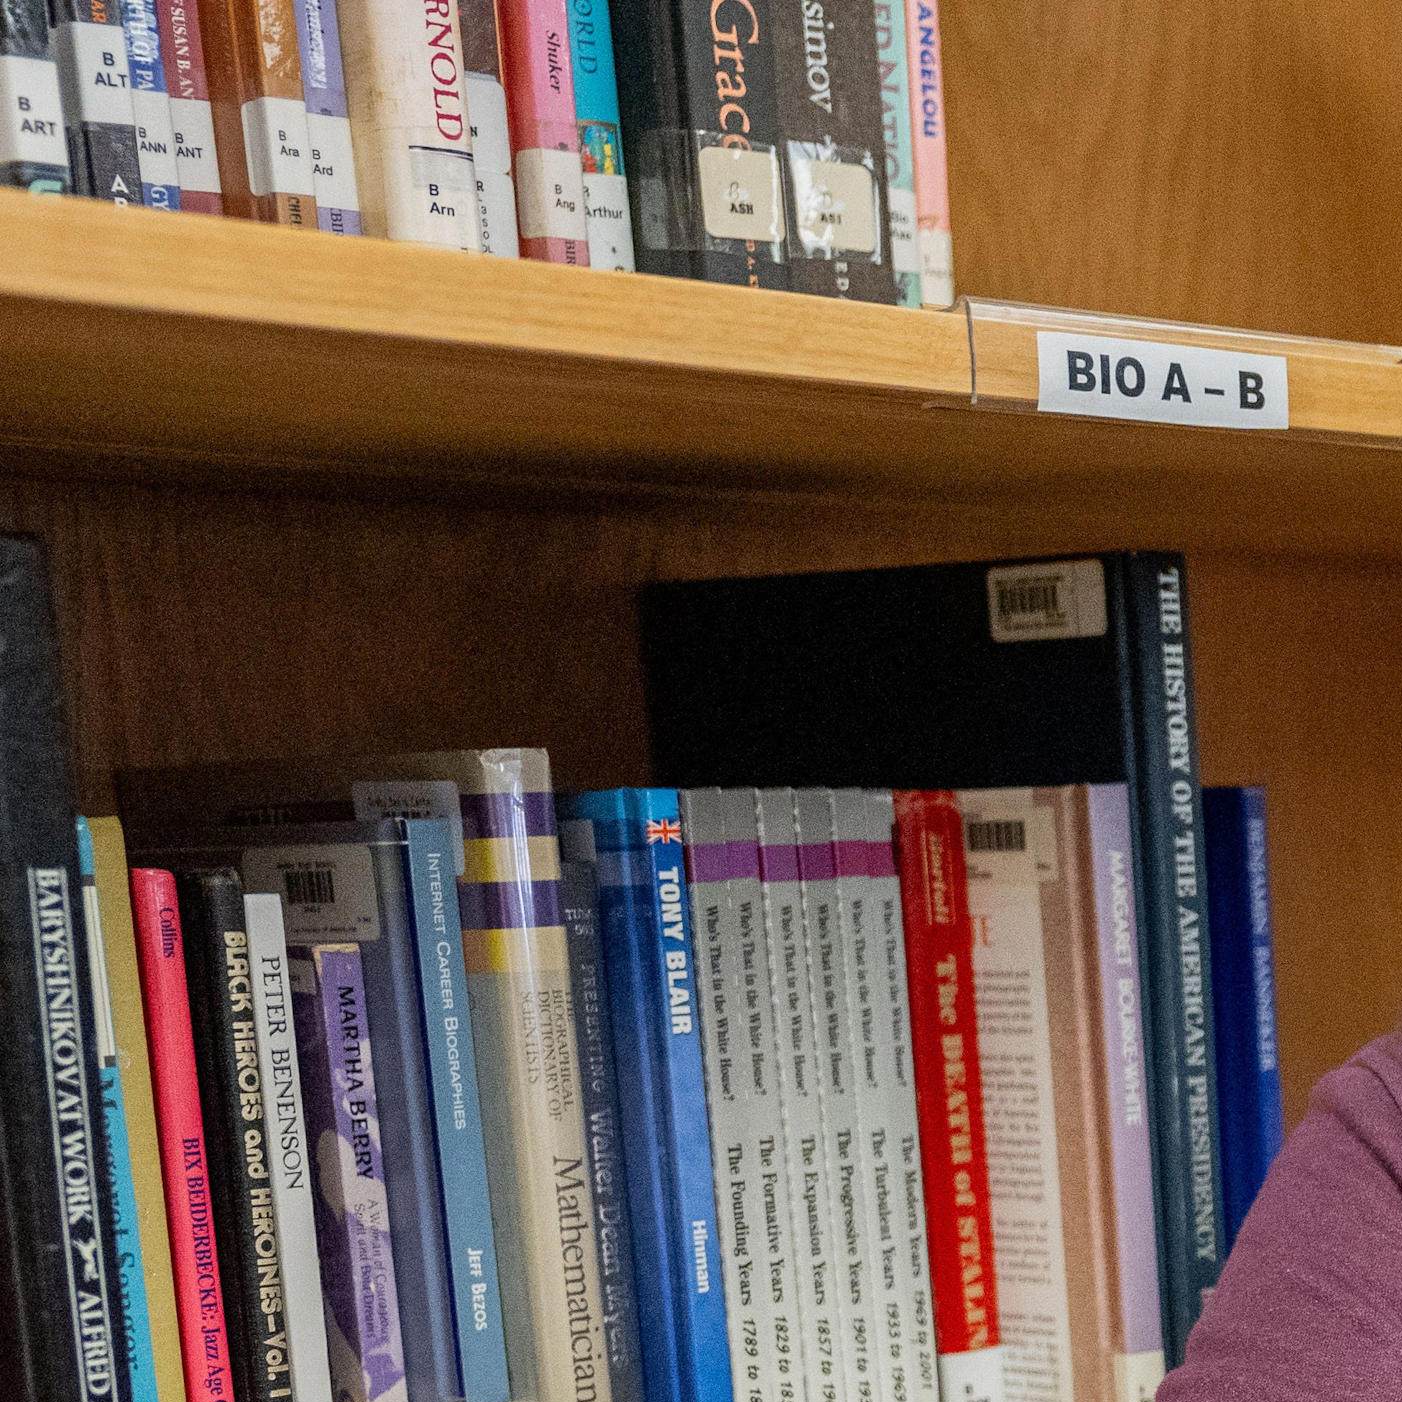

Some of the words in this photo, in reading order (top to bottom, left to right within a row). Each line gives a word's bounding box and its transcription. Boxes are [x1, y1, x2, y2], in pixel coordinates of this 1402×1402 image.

[170, 6, 189, 57] SUSAN
[102, 52, 115, 67] B
[425, 0, 464, 141] RNOLD
[545, 30, 562, 94] Shuker
[802, 0, 835, 114] simov
[94, 72, 128, 89] ALT
[17, 97, 31, 111] B
[20, 122, 57, 137] ART
[138, 127, 147, 139] B
[139, 143, 168, 155] ANN
[175, 132, 184, 144] B
[278, 130, 287, 142] B
[280, 145, 300, 158] Ara
[176, 147, 203, 160] ANT
[312, 149, 321, 161] B
[313, 164, 334, 177] Ard
[429, 183, 440, 197] B
[429, 202, 456, 218] Arn
[554, 184, 562, 195] B
[555, 198, 575, 213] Ang
[730, 202, 755, 215] ASH
[1066, 349, 1147, 399] BIO
[1160, 362, 1192, 404] A
[1238, 370, 1266, 410] B
[1157, 567, 1184, 635] THE
[1162, 642, 1192, 775] HISTORY
[1170, 780, 1194, 825] OF
[1173, 830, 1199, 899] THE
[656, 866, 686, 943] TONY
[160, 907, 178, 958] Collins
[223, 930, 253, 1012] BLACK
[665, 950, 693, 1036] BLAIR
[1177, 904, 1208, 1067] AMERICAN
[261, 955, 288, 1037] PETER
[36, 868, 80, 1084] BARYSHNIKOV
[61, 1127, 92, 1224] WORK
[337, 985, 365, 1093] MARTHA
[537, 990, 559, 1094] DICTIONARY
[716, 1017, 730, 1054] White
[232, 1020, 263, 1121] HEROES
[270, 1047, 305, 1191] BENENSON
[348, 1099, 374, 1180] BERRY
[181, 1137, 203, 1172] BIX
[243, 1128, 269, 1180] and
[589, 1107, 615, 1195] Walter
[726, 1143, 744, 1175] The
[757, 1135, 776, 1167] The
[800, 1134, 817, 1166] The
[836, 1128, 853, 1159] The
[1188, 1074, 1218, 1263] PRESIDENCY
[729, 1180, 752, 1257] Founding
[761, 1173, 783, 1254] Formative
[803, 1171, 823, 1257] Expansion
[187, 1176, 220, 1320] BEIDERBECKE:
[598, 1205, 626, 1275] Dean
[691, 1220, 710, 1294] Hinman
[736, 1260, 755, 1306] Years
[768, 1258, 787, 1304] Years
[811, 1260, 827, 1305] Years
[848, 1259, 863, 1305] Years
[78, 1290, 113, 1395] ALFRED
[201, 1324, 222, 1361] Jazz
[741, 1318, 759, 1357] 1789
[774, 1315, 791, 1354] 1829
[816, 1318, 833, 1356] 1857
[853, 1316, 868, 1353] 1901
[203, 1363, 224, 1396] Age
[746, 1364, 760, 1380] to
[778, 1358, 793, 1374] to
